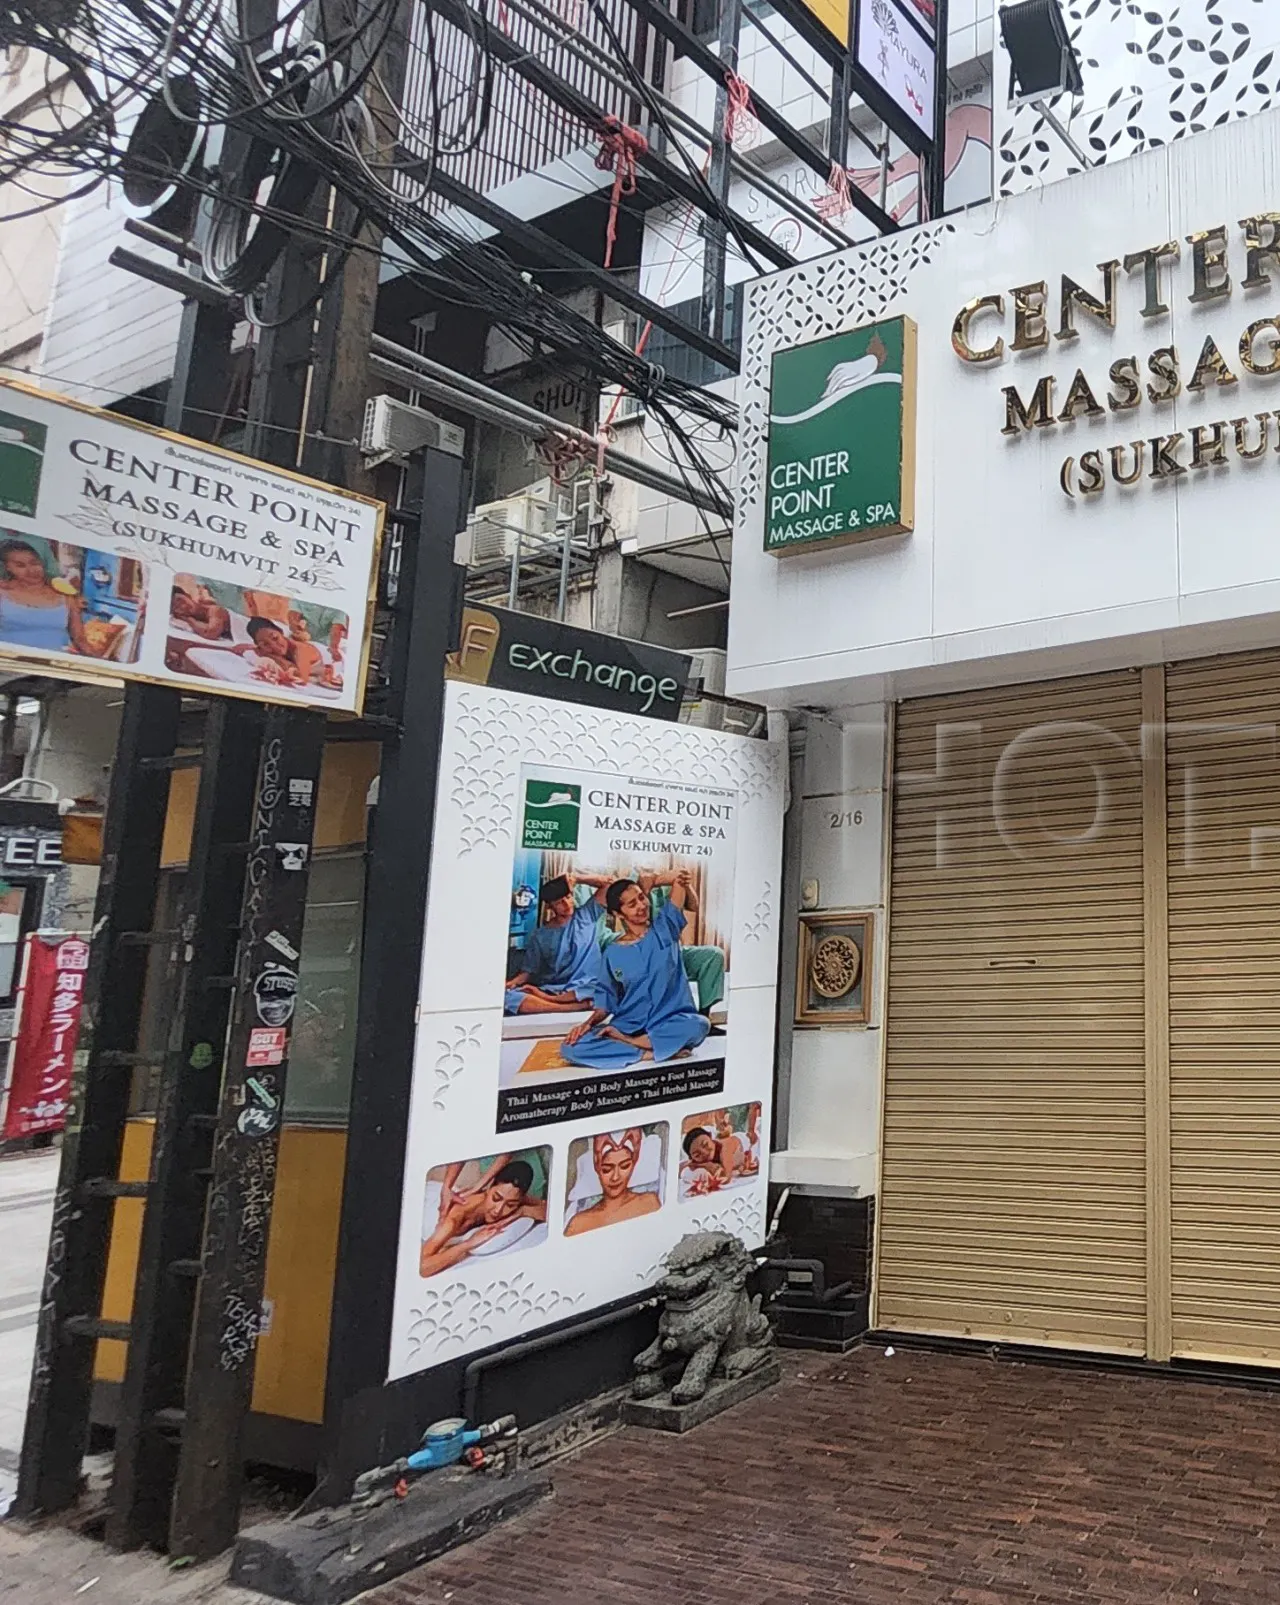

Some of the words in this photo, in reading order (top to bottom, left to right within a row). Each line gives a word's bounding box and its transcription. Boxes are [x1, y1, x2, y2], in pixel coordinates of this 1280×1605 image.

[887, 31, 928, 84] MAYURA
[770, 450, 850, 489] CENTER
[69, 439, 240, 509] CENTER
[248, 492, 361, 543] POINT
[771, 483, 835, 520] POINT
[80, 478, 248, 540] MASSAGE
[260, 530, 282, 550] &
[294, 539, 345, 568] SPA
[769, 513, 844, 544] MASSAGE
[848, 509, 860, 527] &
[866, 502, 896, 523] SPA
[112, 518, 279, 576] (SUKHUMVIT
[287, 565, 318, 586] 24)
[588, 790, 672, 814] CENTER
[676, 800, 734, 820] POINT
[830, 810, 863, 829] 2/16
[525, 819, 559, 830] CENTER
[525, 829, 553, 840] POINT
[594, 816, 676, 835] MASSAGE
[682, 824, 694, 836] &
[699, 825, 726, 839] SPA
[0, 837, 62, 866] EE
[609, 839, 693, 855] (SUKHUMVIT
[697, 845, 713, 857] 24)
[500, 1105, 568, 1123] Aromatherapy
[571, 1099, 594, 1111] Body
[597, 1094, 632, 1106] Massage
[642, 1087, 659, 1099] Thai
[662, 1082, 688, 1095] Herbal
[689, 1079, 720, 1091] Massage
[506, 1094, 529, 1107] Thai
[532, 1090, 572, 1103] Massage
[583, 1084, 597, 1095] Oil
[600, 1081, 622, 1092] Body
[625, 1076, 659, 1088] Massage
[668, 1071, 685, 1081] Foot
[687, 1067, 717, 1078] Massage
